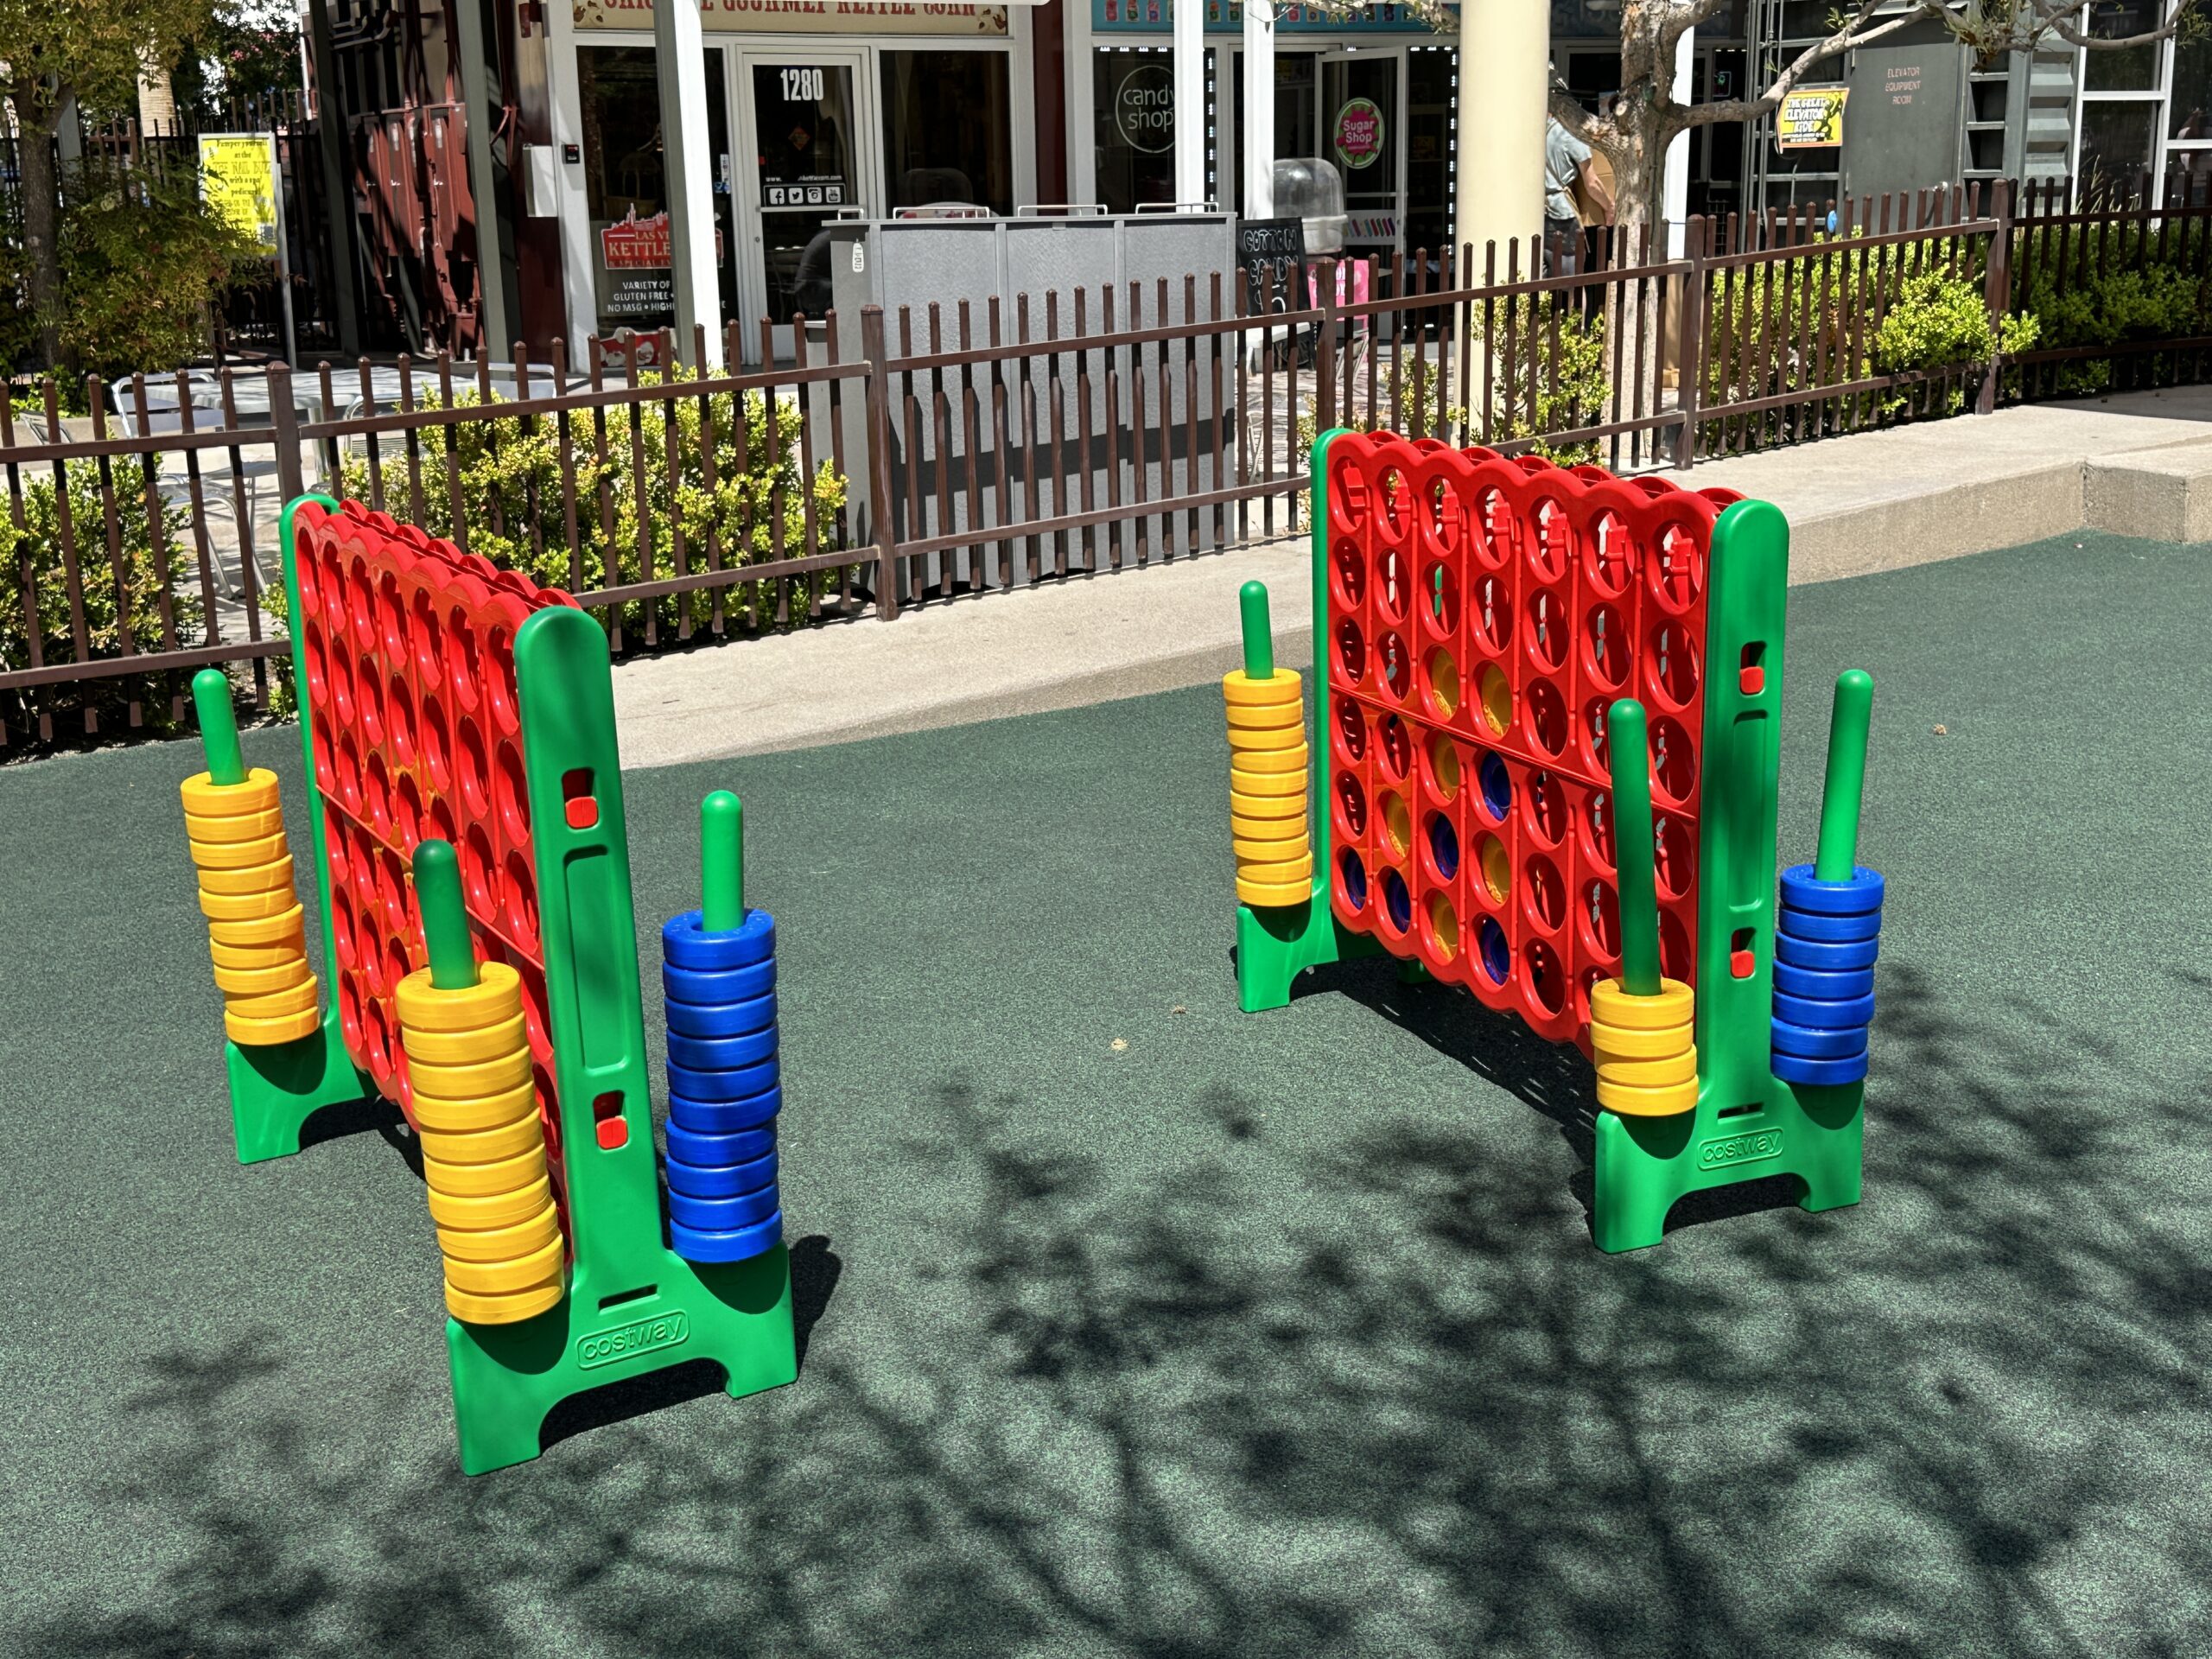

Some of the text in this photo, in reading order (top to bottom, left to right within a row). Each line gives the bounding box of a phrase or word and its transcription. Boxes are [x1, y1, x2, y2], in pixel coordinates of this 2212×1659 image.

[1887, 67, 1920, 78] ELEVATOR
[780, 69, 823, 101] 1280
[1885, 80, 1921, 92] EQUIPMENT
[1892, 95, 1912, 105] ROOM
[1128, 106, 1174, 133] shop
[1783, 108, 1824, 121] ELEVATOR
[1343, 119, 1375, 133] Sugar
[1345, 132, 1372, 145] Shop
[636, 231, 655, 240] LAS
[1243, 228, 1296, 251] COTTON
[608, 242, 671, 257] KETTLE
[622, 281, 671, 289] VARIETY OF
[613, 291, 669, 302] GLUTEN FREE
[1702, 1133, 1780, 1162] costway
[582, 1316, 682, 1359] costway
